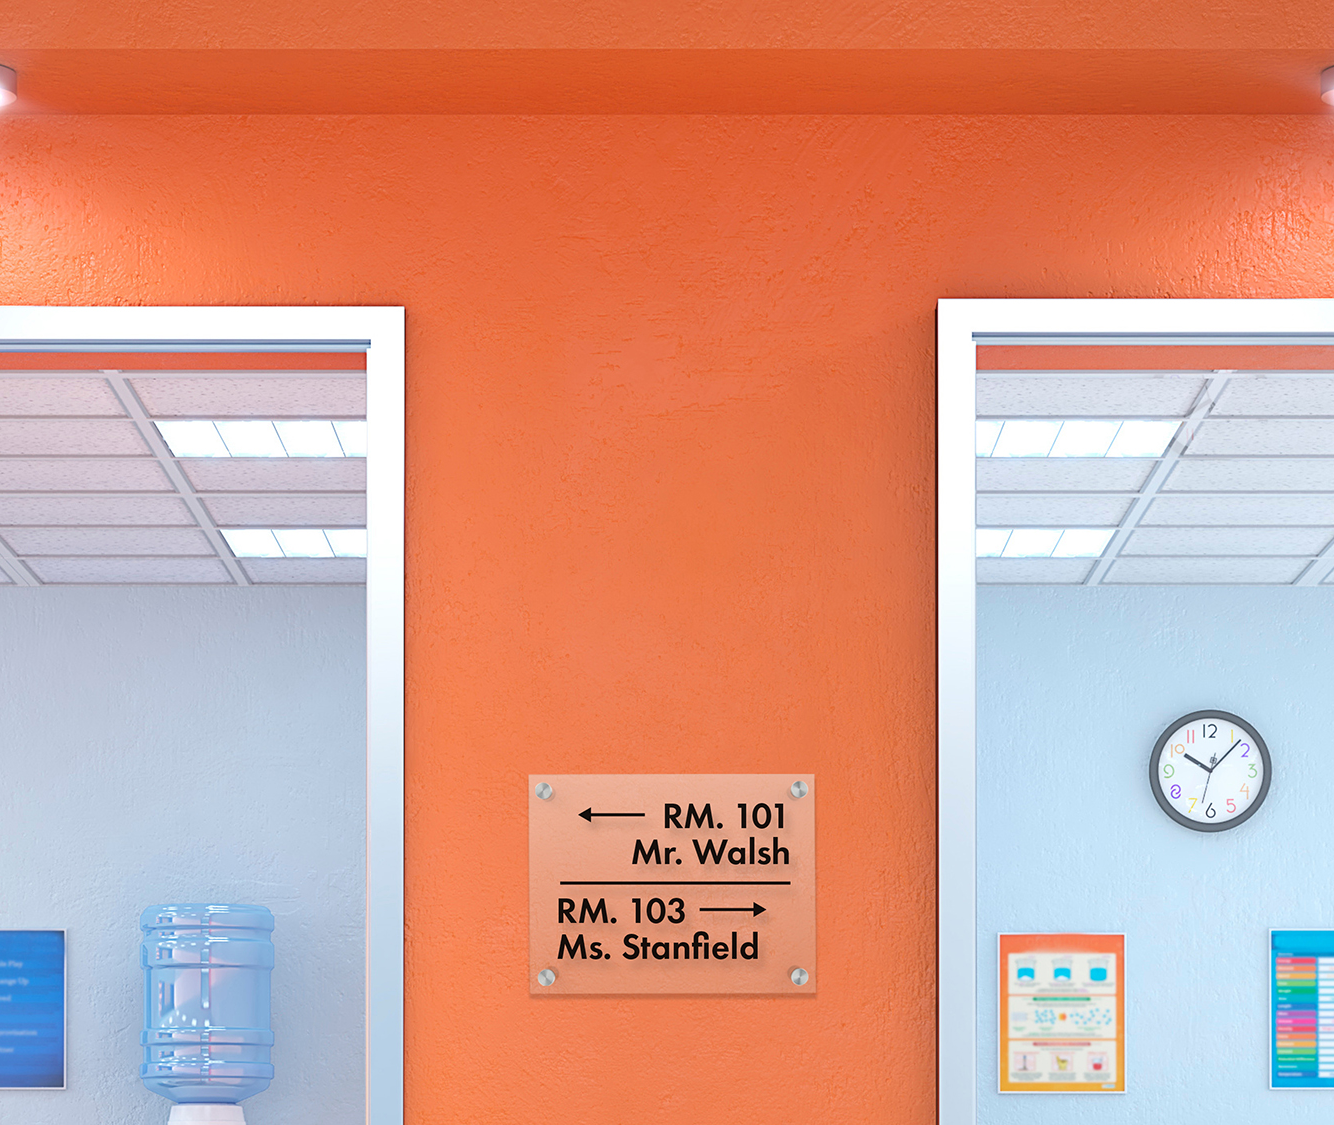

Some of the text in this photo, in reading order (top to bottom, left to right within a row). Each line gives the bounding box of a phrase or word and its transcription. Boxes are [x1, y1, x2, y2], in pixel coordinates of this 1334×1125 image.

[1187, 729, 1194, 743] 11
[1203, 724, 1217, 738] 12
[1230, 729, 1234, 743] 1
[1171, 743, 1185, 758] 10
[1240, 743, 1250, 757] 2
[1164, 764, 1174, 778] 9
[1248, 764, 1257, 778] 3
[1170, 784, 1181, 799] 8
[1240, 783, 1250, 800] 4
[1188, 798, 1197, 813] 7
[1205, 803, 1216, 818] 6
[1226, 799, 1236, 813] 5
[665, 803, 783, 829] RM. 101
[632, 837, 789, 865] Mr. Walsh
[559, 898, 685, 923] RM. 103
[558, 931, 758, 959] Ms. Stanfield
